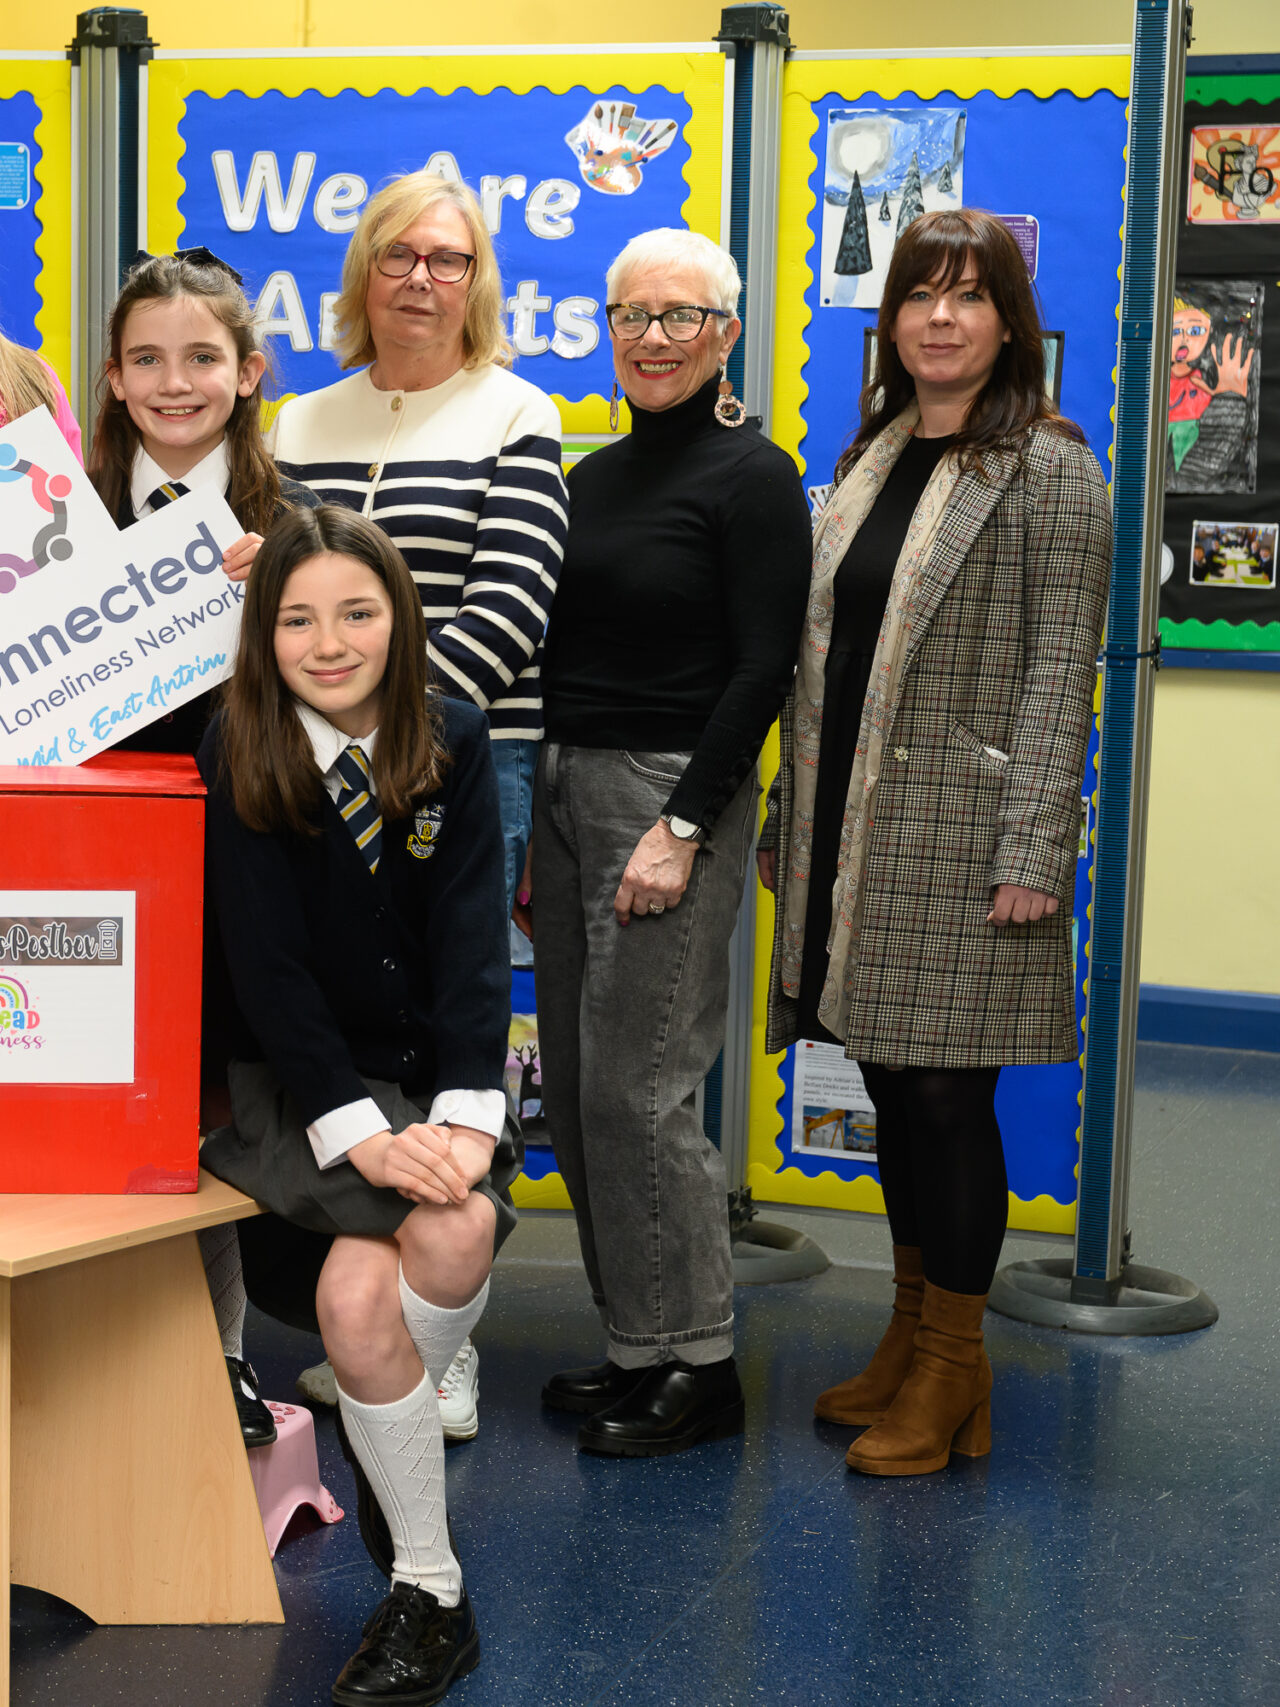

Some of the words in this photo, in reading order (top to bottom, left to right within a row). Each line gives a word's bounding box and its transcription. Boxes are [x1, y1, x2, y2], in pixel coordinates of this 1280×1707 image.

[211, 150, 368, 234] We
[134, 582, 245, 657] Network
[67, 727, 87, 754] &
[89, 692, 144, 741] East
[146, 653, 227, 707] Antrim
[7, 921, 99, 961] Postbox
